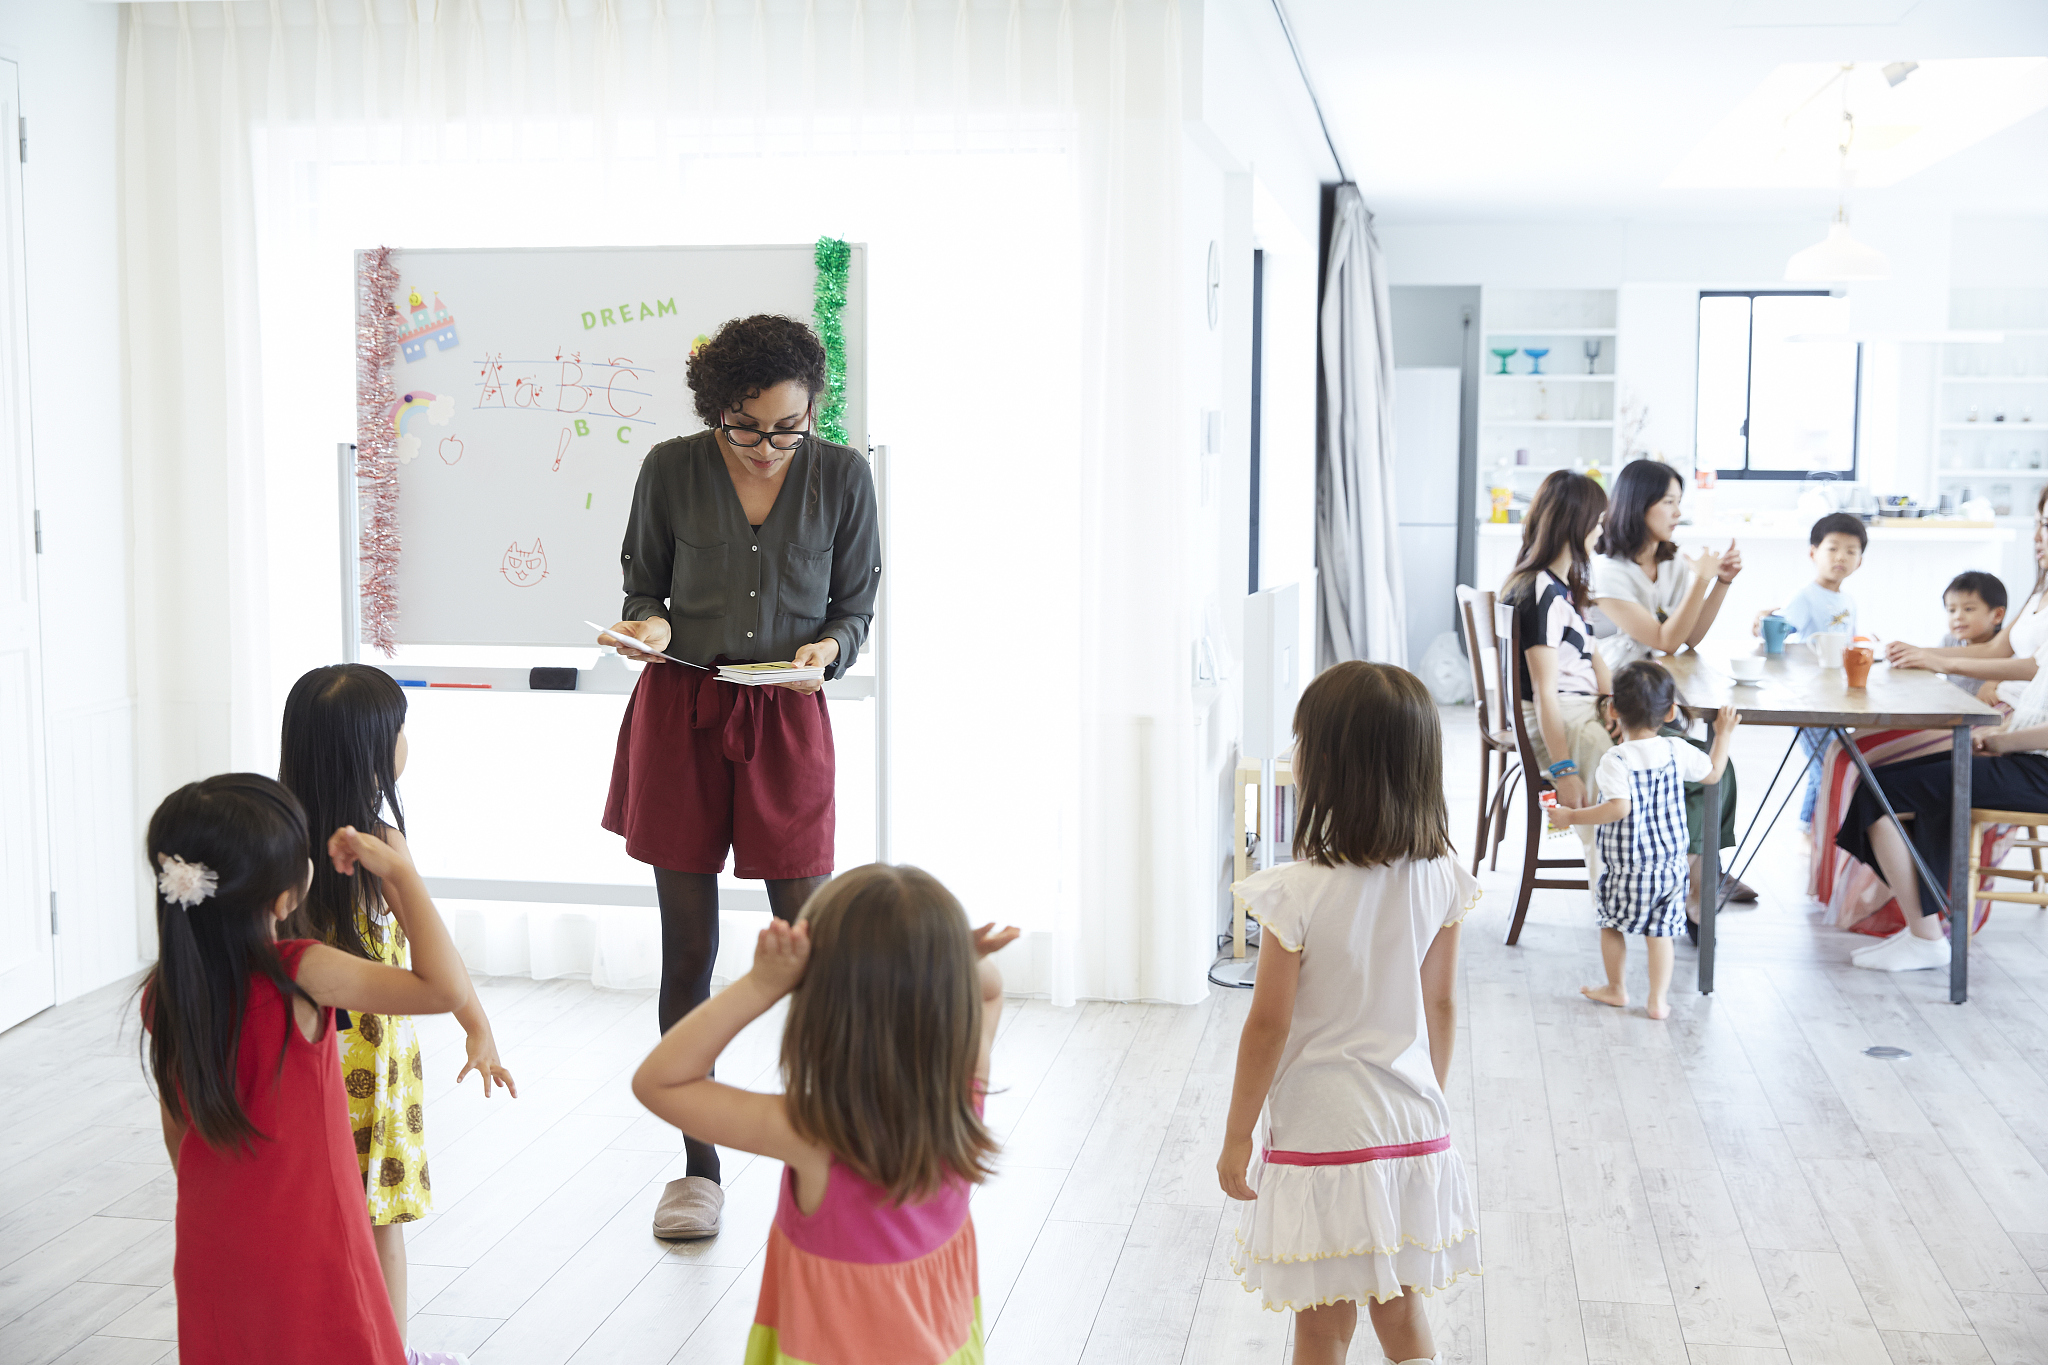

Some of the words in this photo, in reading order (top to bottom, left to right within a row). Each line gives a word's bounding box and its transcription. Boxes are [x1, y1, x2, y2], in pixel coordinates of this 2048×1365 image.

[581, 297, 678, 330] DREAM
[574, 419, 590, 437] B
[616, 426, 632, 444] C
